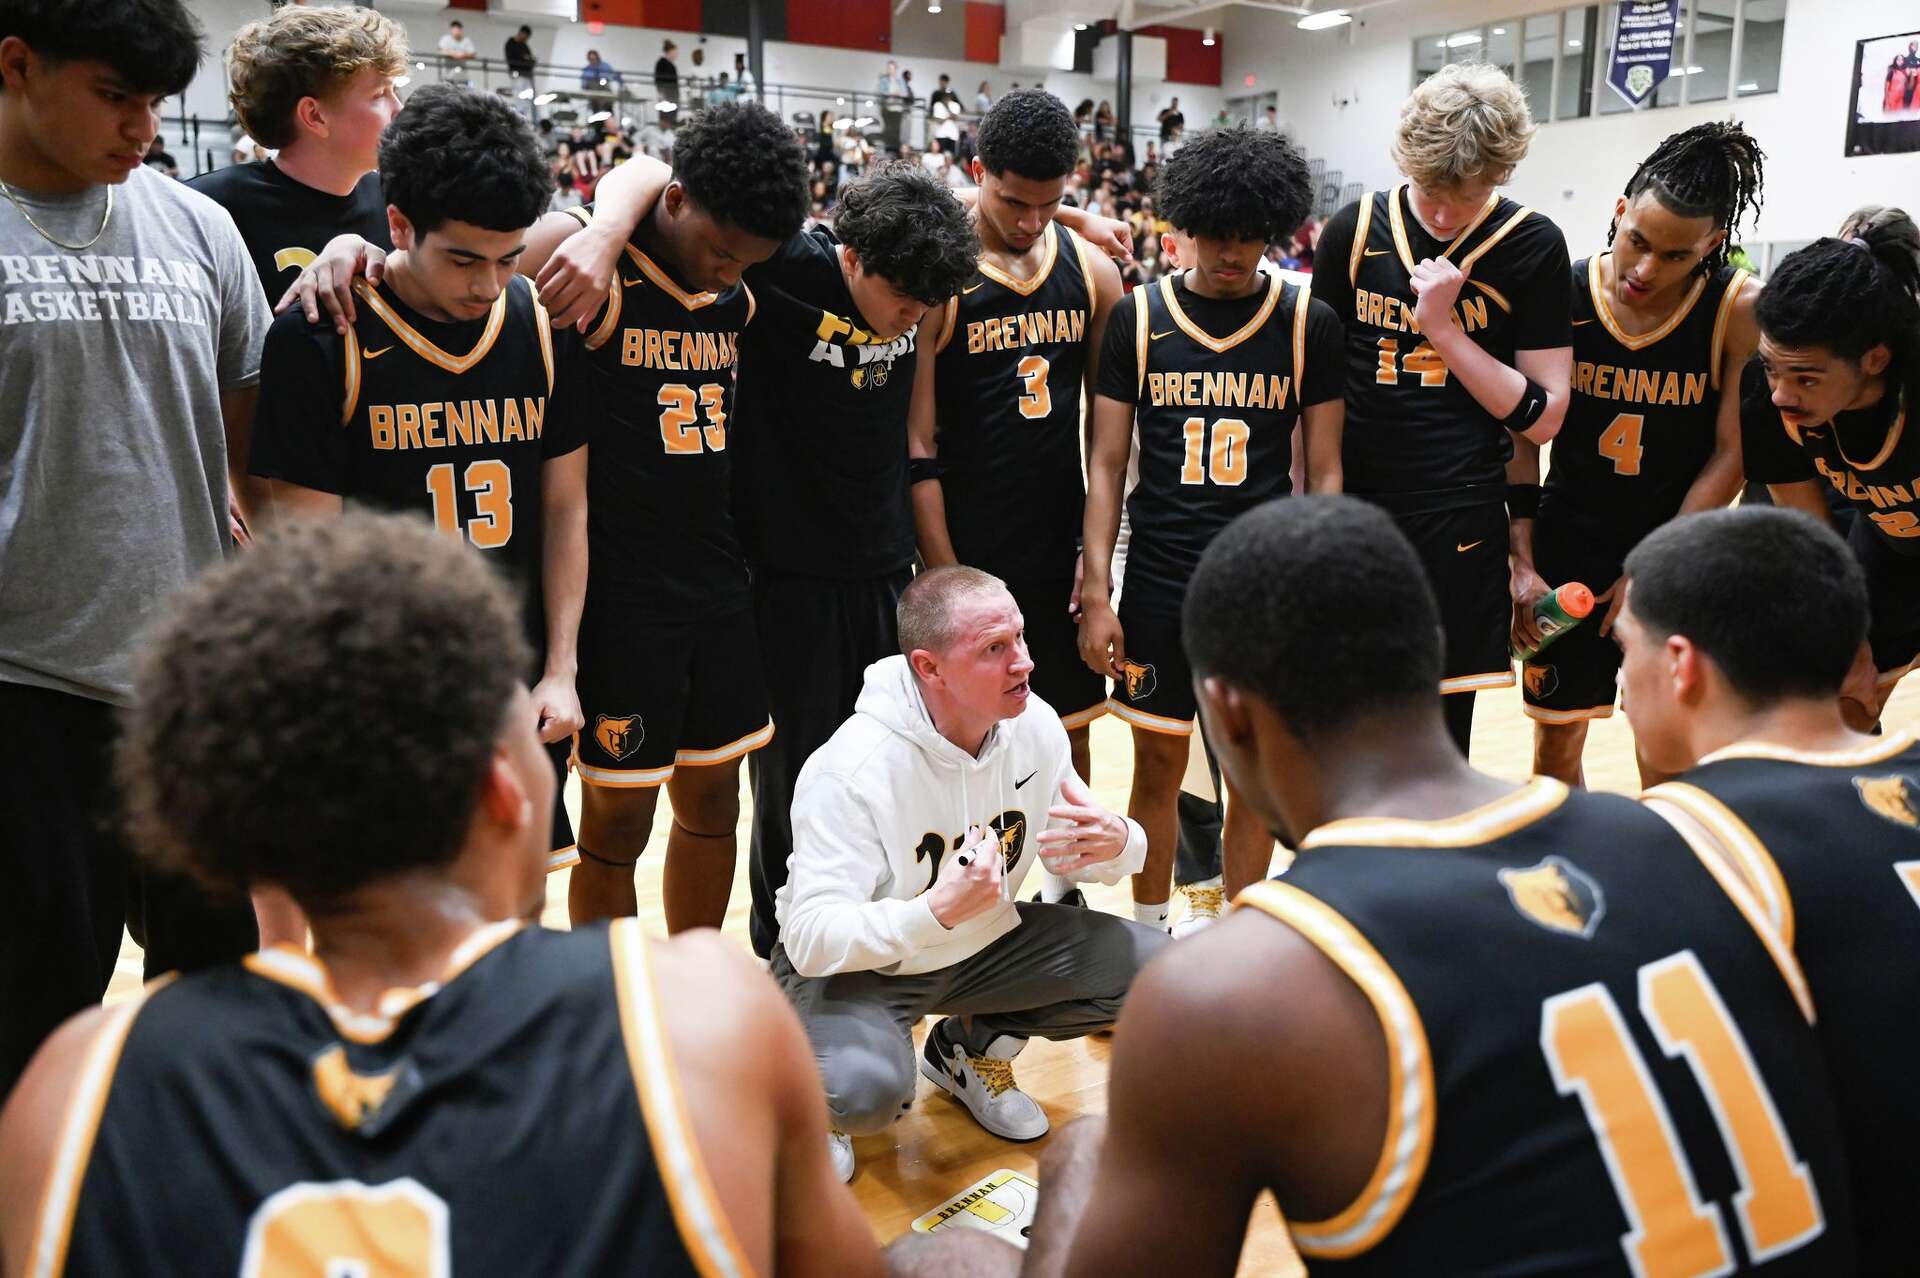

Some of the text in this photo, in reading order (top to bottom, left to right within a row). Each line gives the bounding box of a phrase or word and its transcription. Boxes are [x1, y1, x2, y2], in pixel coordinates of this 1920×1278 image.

[0, 255, 201, 290] RENNAN
[0, 291, 206, 326] ASKETBALL
[967, 310, 1085, 354] BRENNAN
[1356, 288, 1488, 335] BRENN
[1016, 355, 1052, 419] 3
[1376, 337, 1449, 387] 14
[1148, 372, 1290, 410] BRENNAN
[368, 397, 545, 450] BRENNAN
[657, 383, 727, 455] 23
[1598, 412, 1645, 476] 4
[1180, 417, 1251, 486] 10
[426, 459, 513, 550] 13
[1541, 948, 1826, 1278] 11
[937, 1182, 998, 1221] BRENNAN
